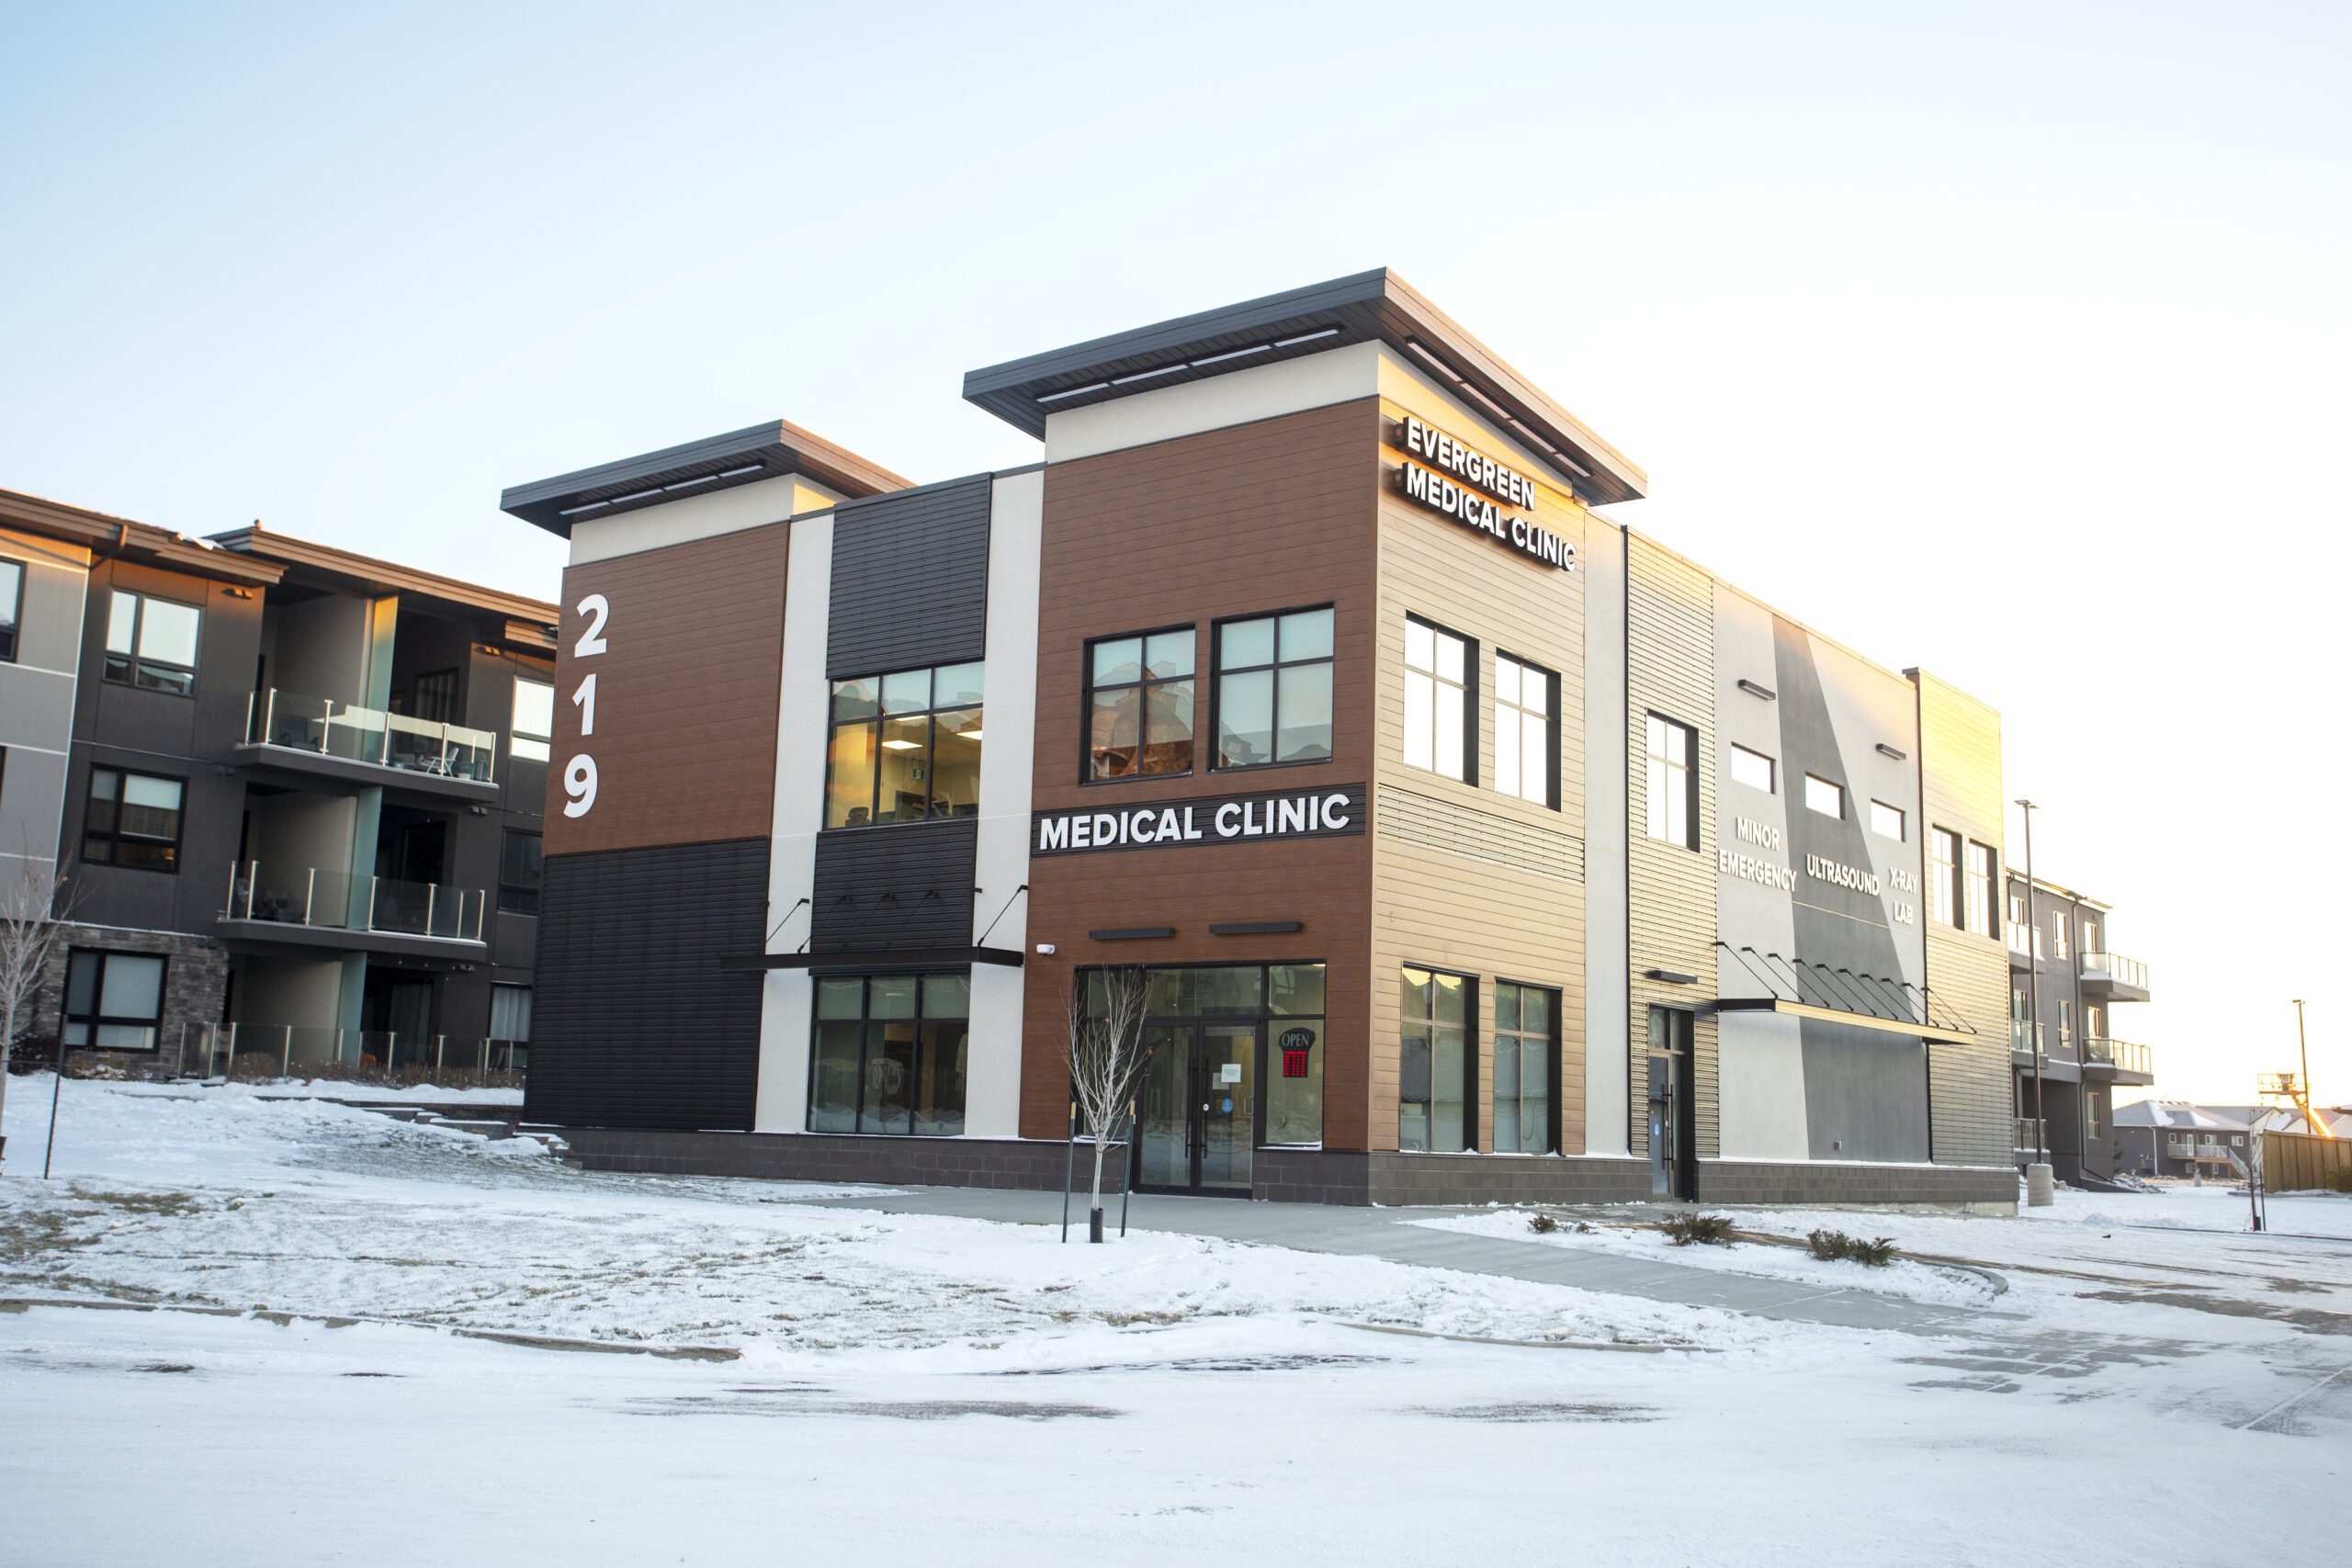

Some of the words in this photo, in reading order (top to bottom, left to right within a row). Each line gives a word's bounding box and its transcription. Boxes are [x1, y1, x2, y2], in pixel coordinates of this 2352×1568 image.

[1405, 416, 1535, 511] EVERGREEN
[1405, 462, 1507, 539] MEDICAL
[1510, 517, 1577, 572] CLINIC
[563, 593, 609, 818] 219
[1040, 807, 1202, 850] MEDICAL
[1215, 794, 1350, 838] CLINIC
[1736, 816, 1781, 852] MINOR
[1718, 849, 1797, 893] EMERGENCY
[1805, 853, 1880, 897] ULTRASOUND
[1889, 867, 1919, 895] X-RAY
[1894, 901, 1914, 925] LAB
[1282, 1033, 1309, 1046] OPEN
